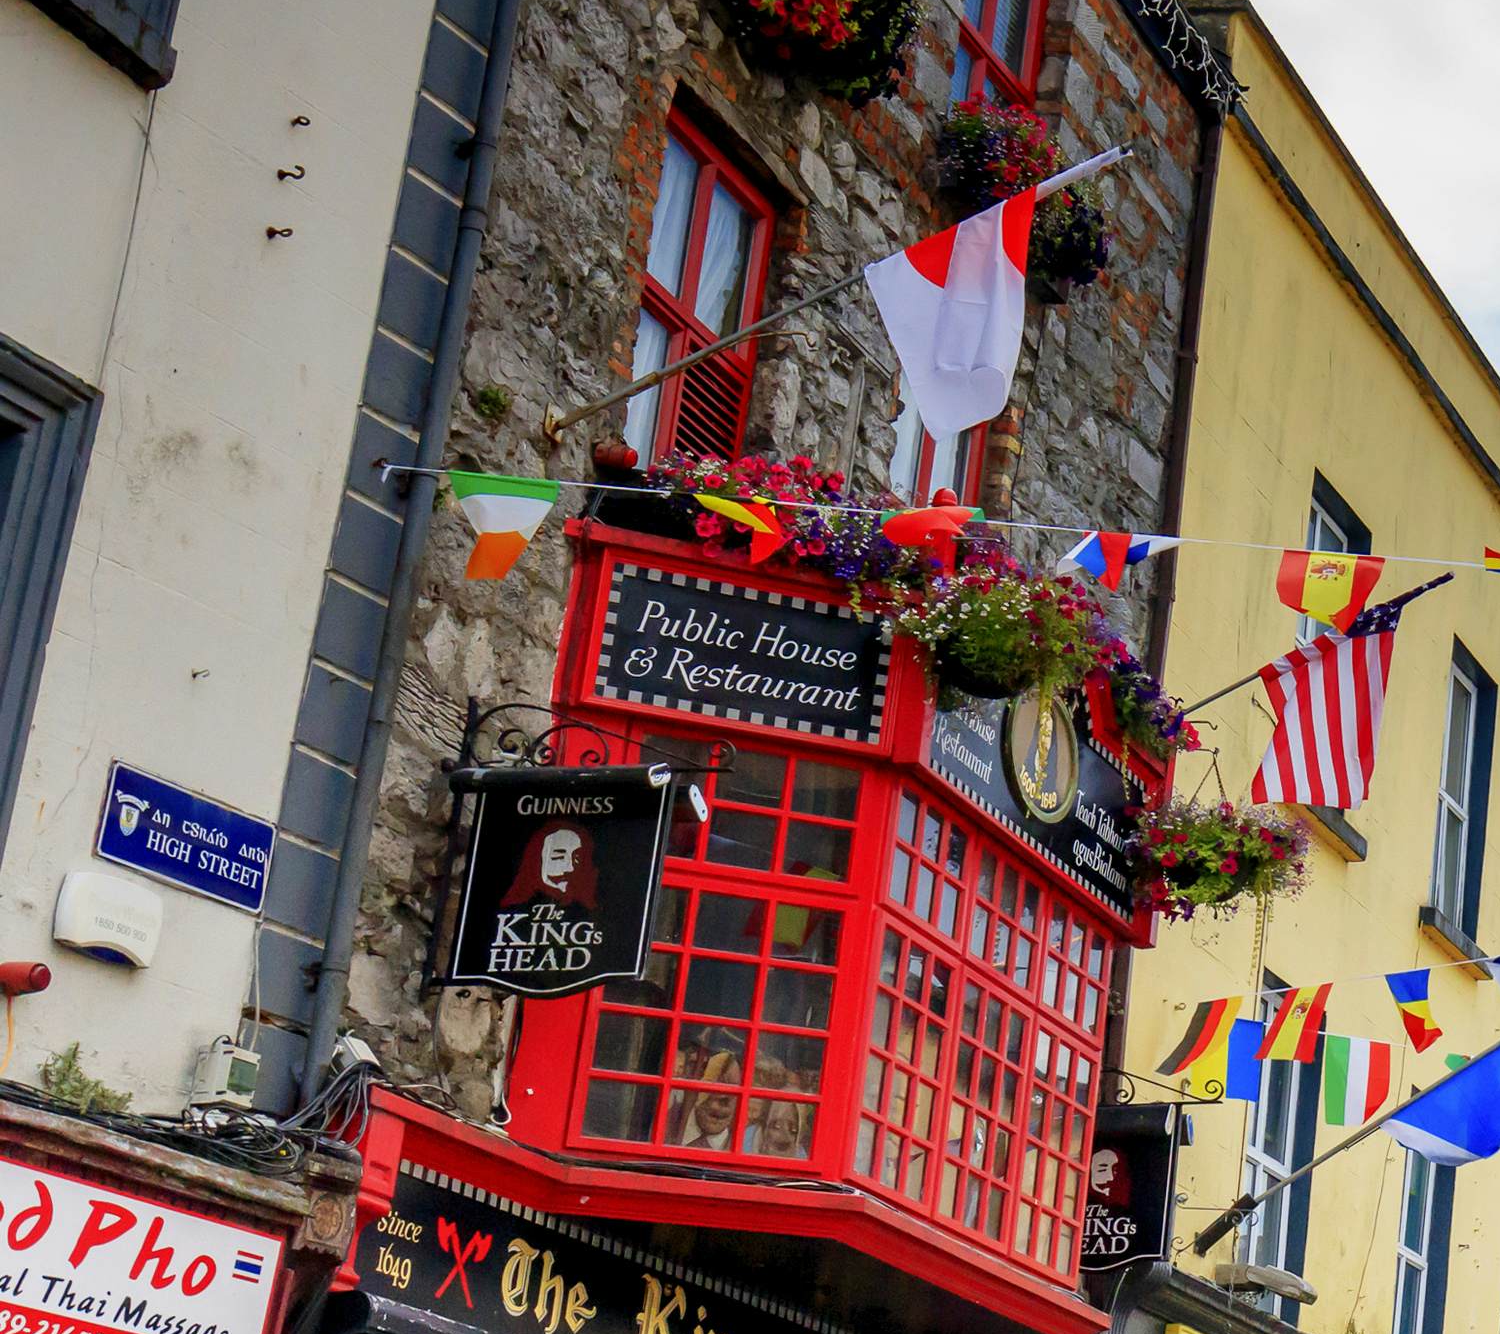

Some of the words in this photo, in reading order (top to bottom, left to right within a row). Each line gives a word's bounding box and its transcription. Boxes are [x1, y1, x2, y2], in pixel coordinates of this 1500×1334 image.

[637, 600, 744, 651] Public
[750, 622, 857, 671] House
[624, 646, 657, 677] &
[662, 647, 861, 711] Restaurant
[936, 720, 993, 785] Restaurant
[517, 795, 614, 815] GUINNESS
[147, 830, 192, 863] HIGH
[198, 850, 261, 889] STREET
[532, 904, 564, 921] The
[487, 947, 591, 973] HEAD
[1084, 1217, 1137, 1235] INGs
[1086, 1204, 1109, 1217] The
[68, 1200, 216, 1297] Pho
[1081, 1235, 1129, 1255] EAD
[376, 1247, 412, 1290] 1649
[500, 1237, 597, 1334] The
[42, 1275, 111, 1317] Thai
